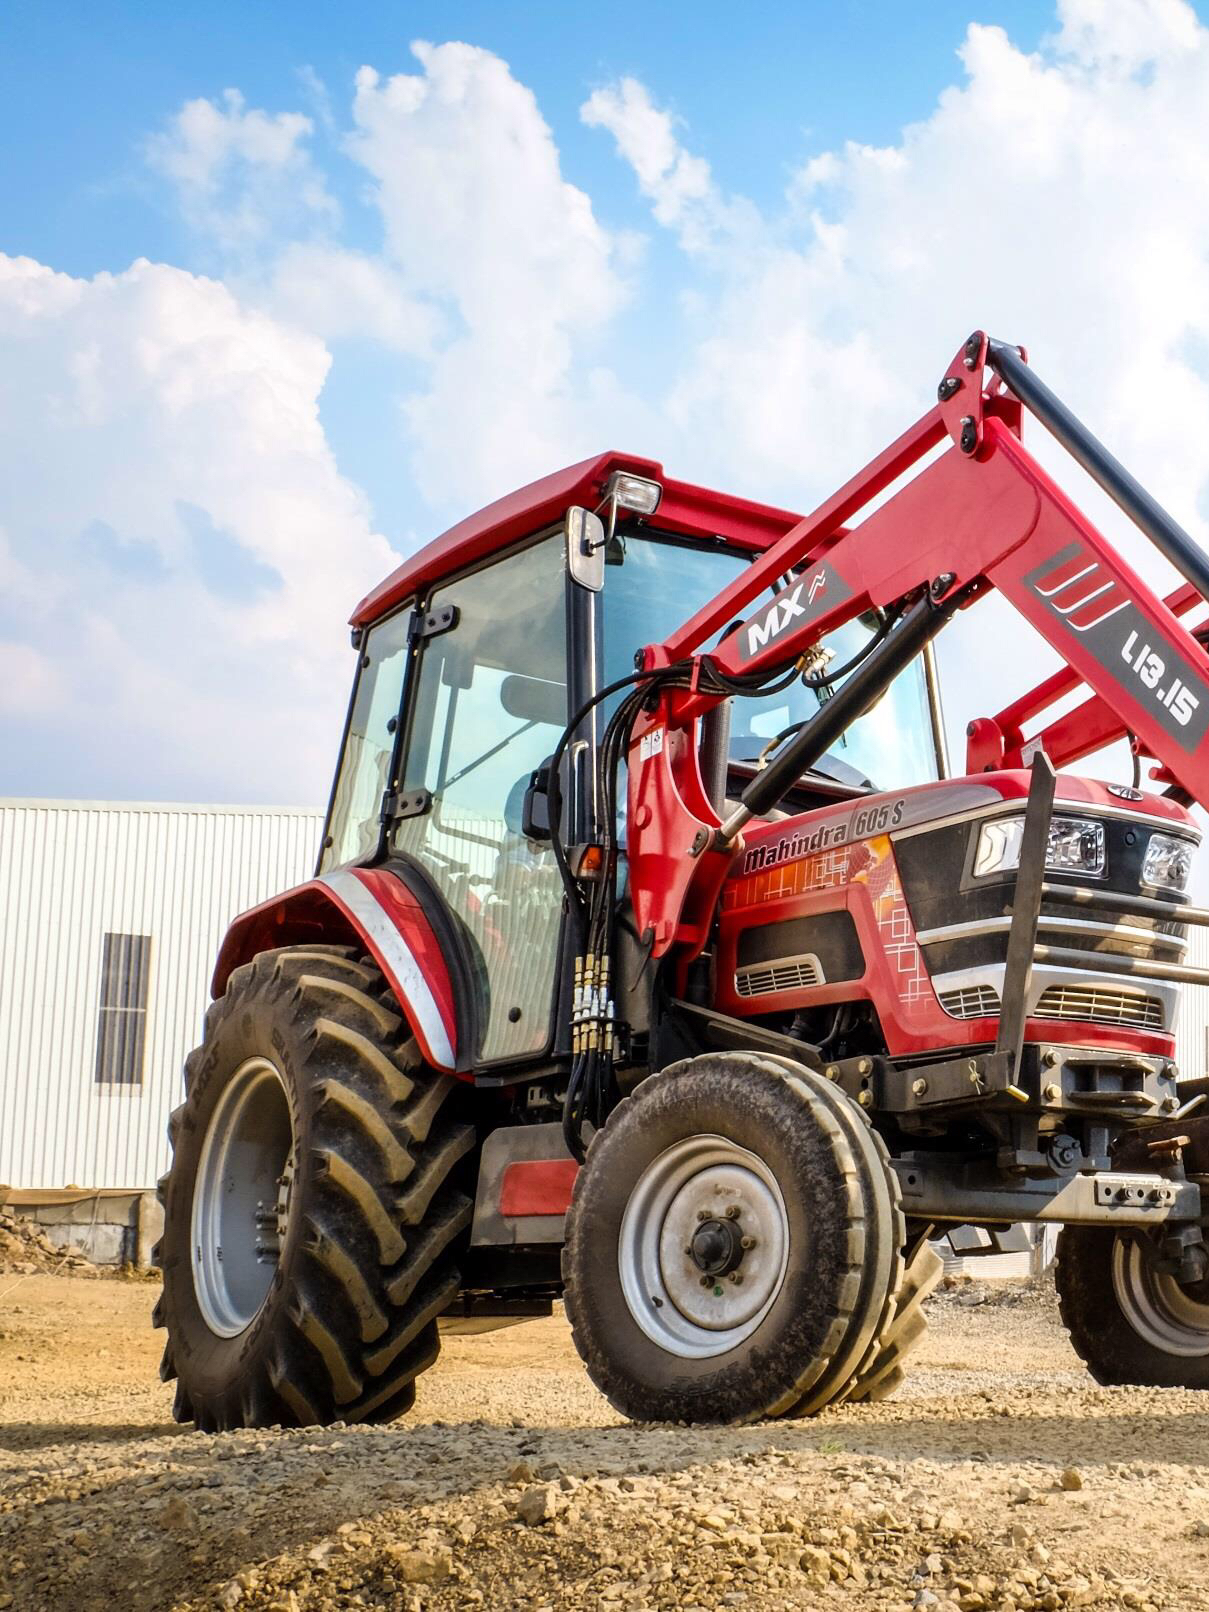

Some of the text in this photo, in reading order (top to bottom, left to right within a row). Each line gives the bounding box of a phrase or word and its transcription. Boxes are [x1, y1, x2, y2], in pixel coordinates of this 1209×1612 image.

[747, 583, 806, 656] MX
[1121, 630, 1200, 726] L13.15
[744, 823, 848, 875] Mahindra
[855, 804, 891, 836] 605
